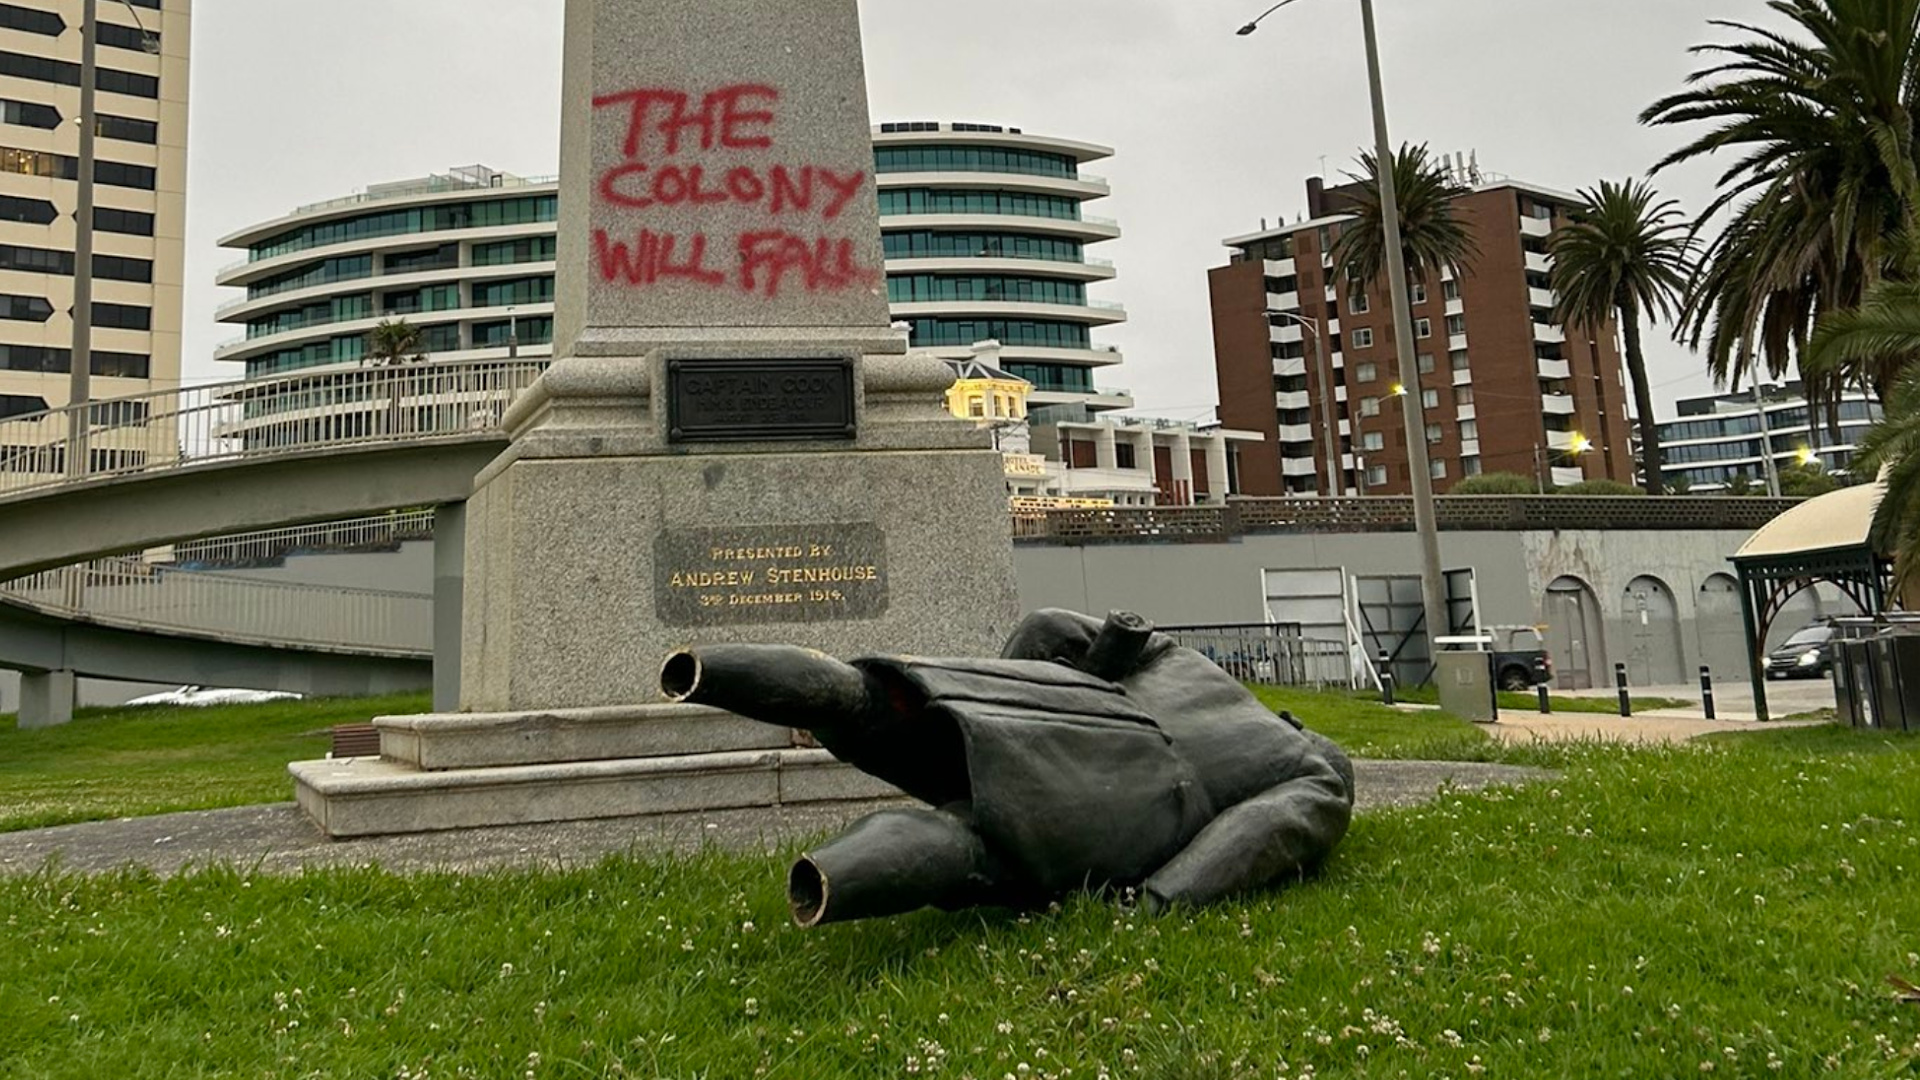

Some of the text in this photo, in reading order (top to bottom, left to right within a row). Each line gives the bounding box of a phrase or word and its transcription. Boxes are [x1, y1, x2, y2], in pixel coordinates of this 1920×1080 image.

[592, 83, 778, 157] THE
[599, 162, 865, 220] COLONY
[592, 228, 880, 297] WILL FALL
[685, 375, 839, 396] CAPTAIN COOK
[712, 543, 832, 560] PRESENTED BY
[670, 566, 878, 587] ANDREW STENHOUSE
[729, 593, 802, 605] DECEMBER
